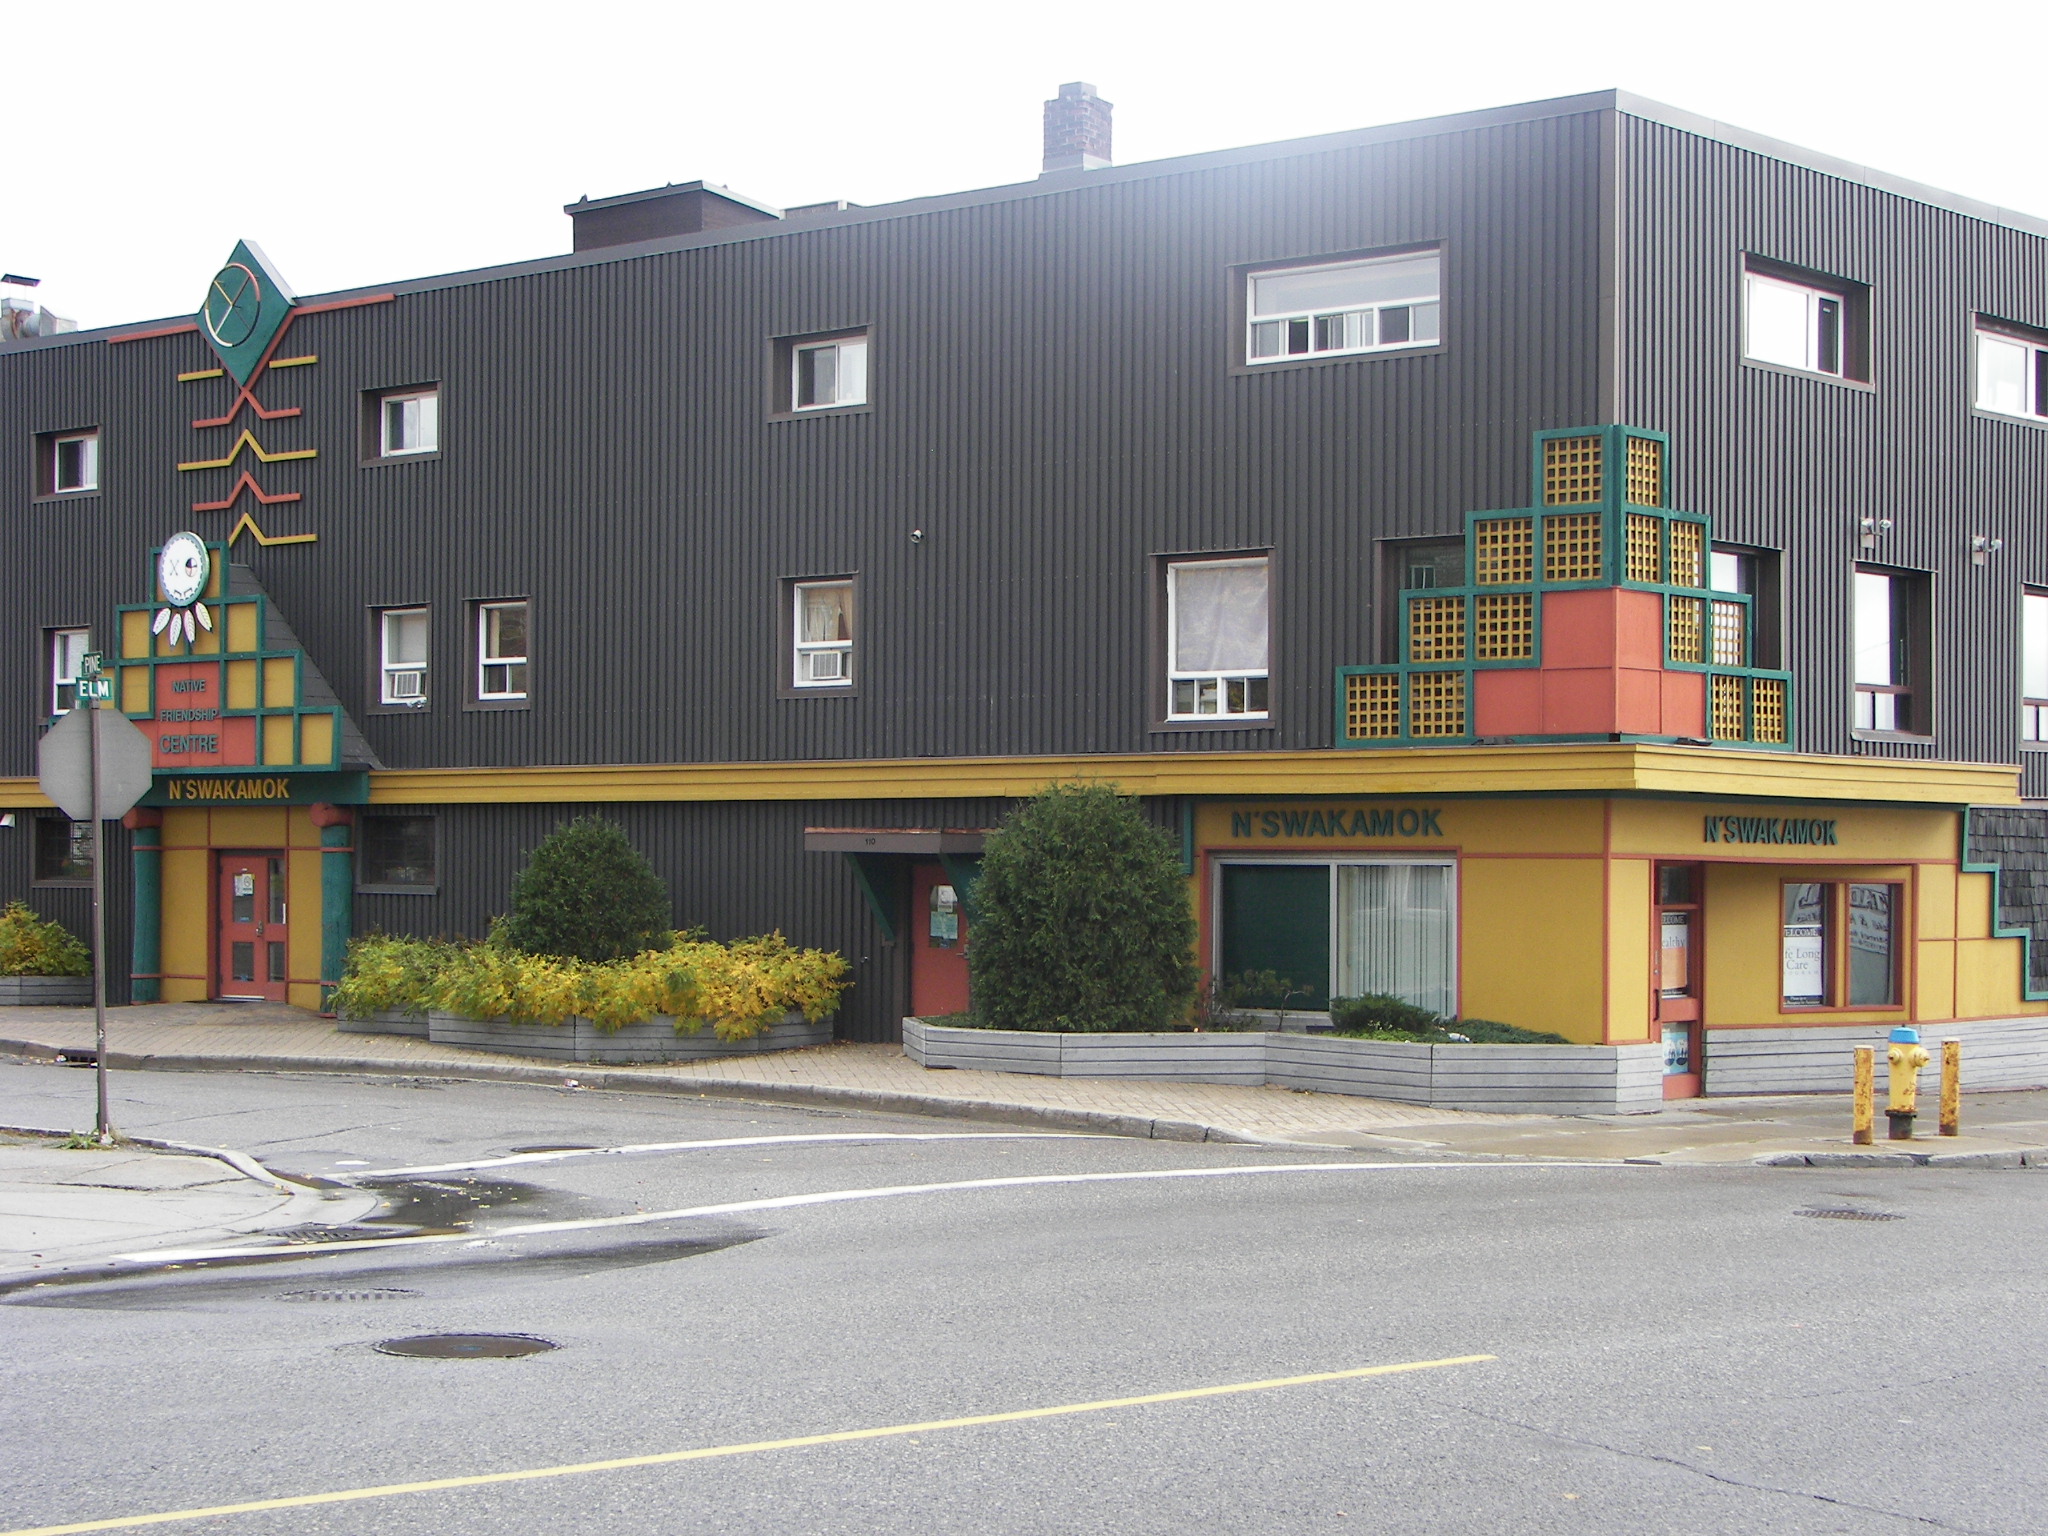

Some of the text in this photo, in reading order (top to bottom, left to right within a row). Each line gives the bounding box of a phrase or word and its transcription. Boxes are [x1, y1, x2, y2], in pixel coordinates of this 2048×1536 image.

[84, 655, 101, 673] PINE
[79, 680, 109, 697] ELM
[172, 679, 206, 693] NATIVE
[160, 708, 218, 722] FRIENDSHIP
[159, 734, 219, 754] CENTRE
[169, 778, 290, 800] N'SWAKAMOK
[1231, 808, 1443, 838] N'SWAKAMOK
[1704, 815, 1838, 846] N'SWAKAMOK
[865, 837, 876, 846] 110
[1785, 928, 1819, 937] ELCOME
[1662, 936, 1685, 948] ealthy
[1796, 948, 1820, 961] Long
[1786, 959, 1809, 970] Care
